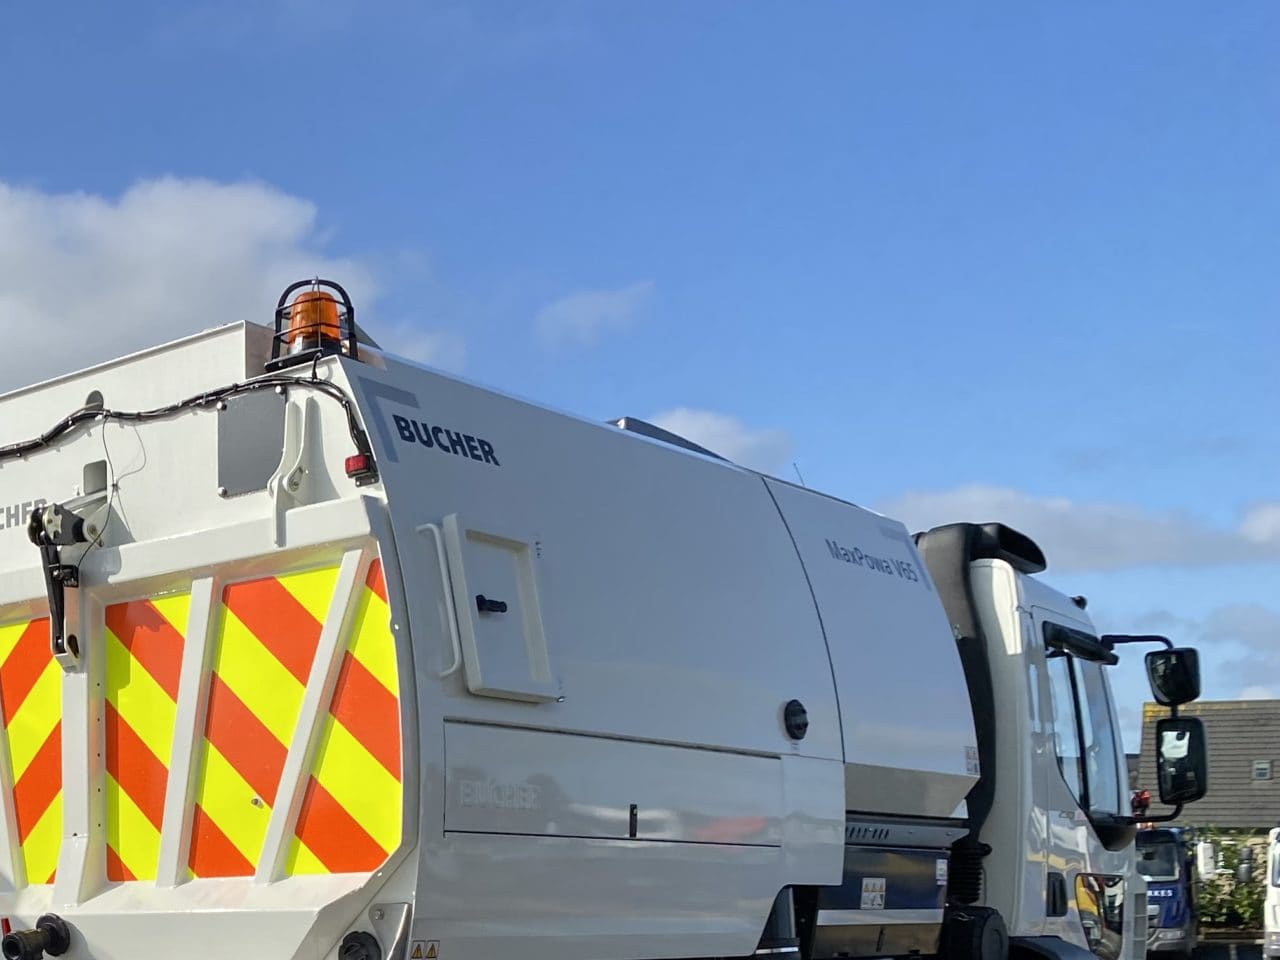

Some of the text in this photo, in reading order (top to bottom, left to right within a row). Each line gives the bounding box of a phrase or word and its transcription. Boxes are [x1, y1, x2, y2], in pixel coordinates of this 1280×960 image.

[392, 414, 501, 466] BUCHER
[825, 538, 918, 582] MaxPowa V65
